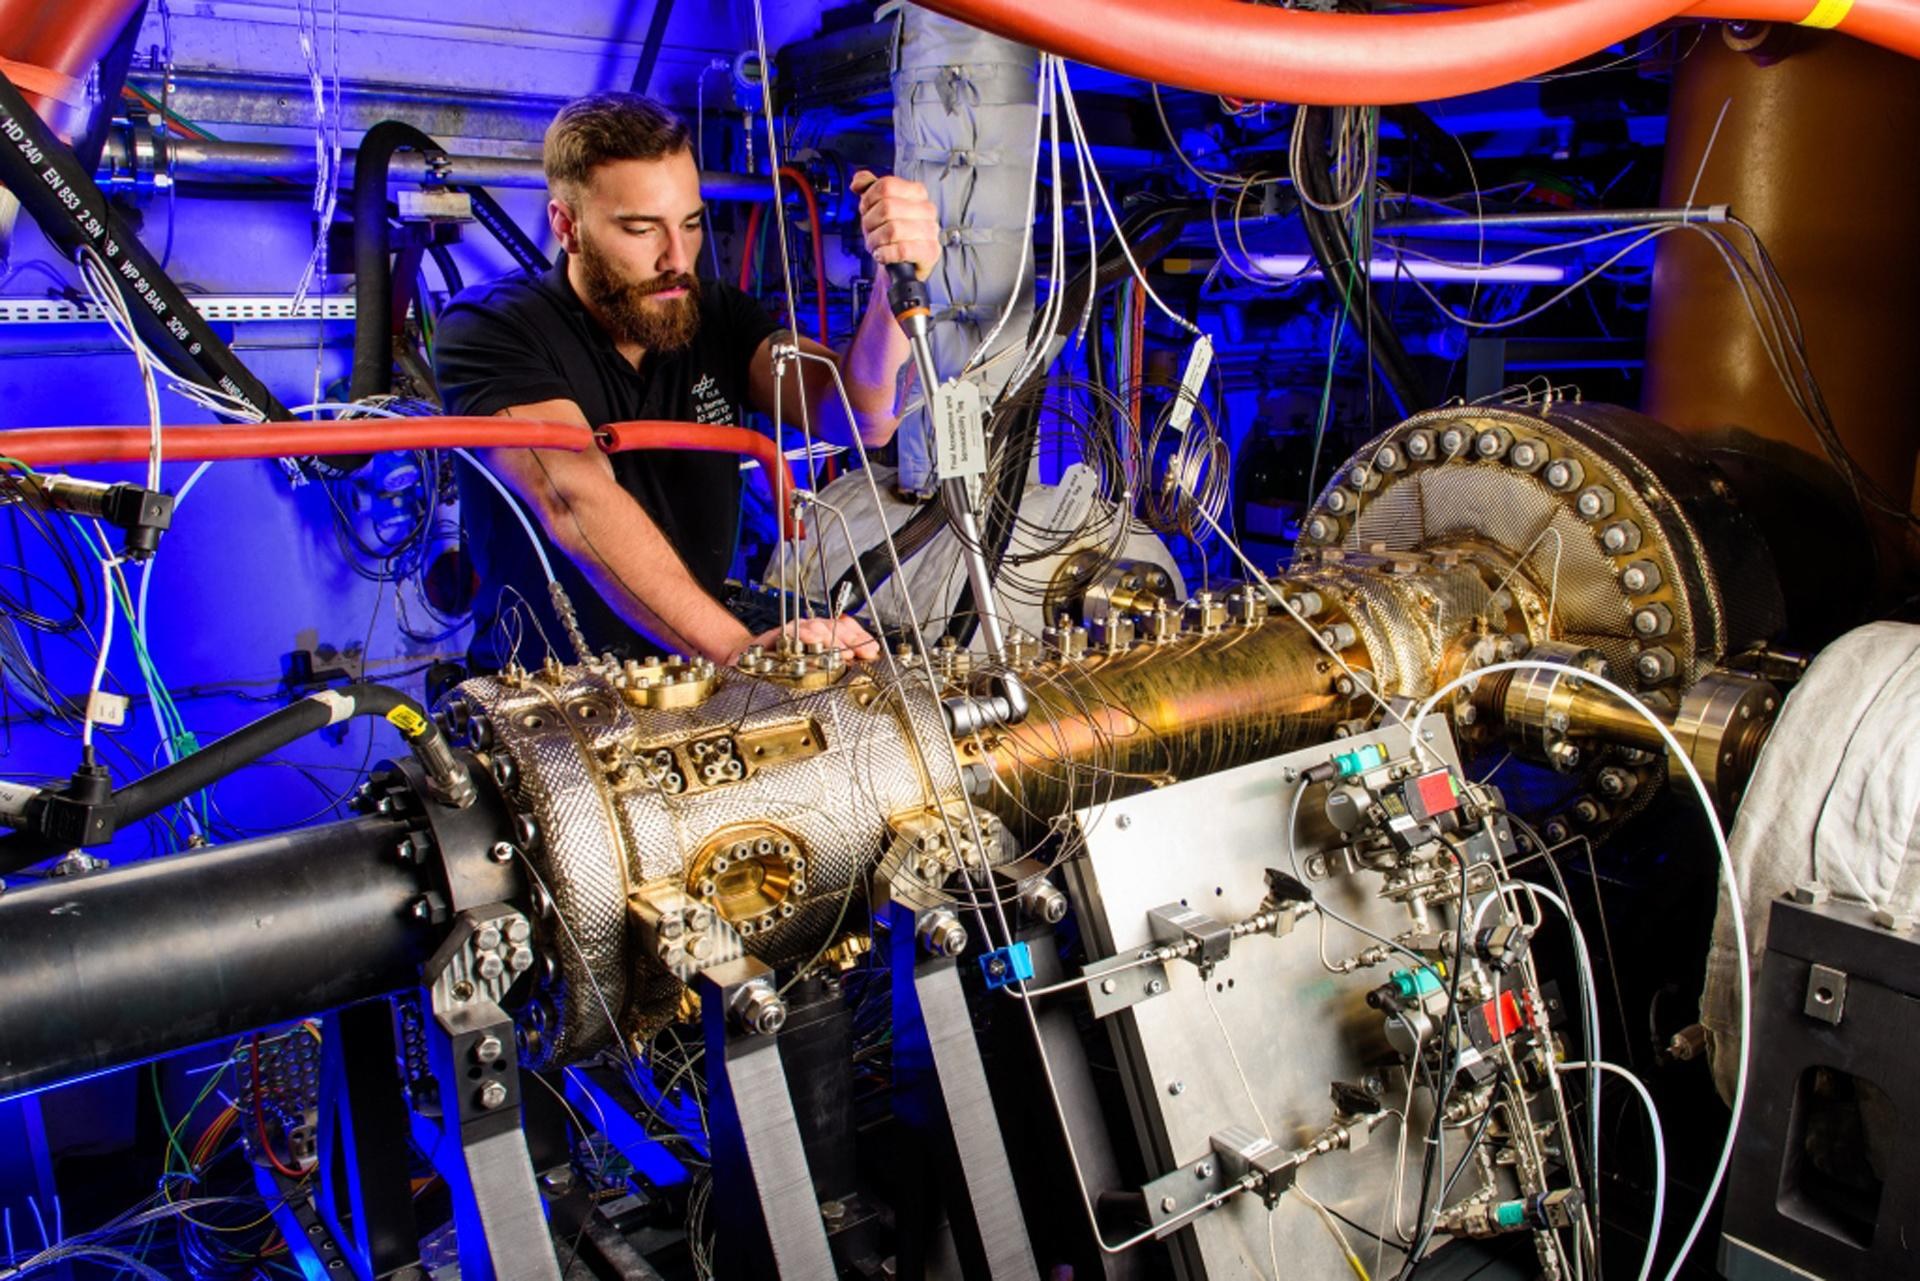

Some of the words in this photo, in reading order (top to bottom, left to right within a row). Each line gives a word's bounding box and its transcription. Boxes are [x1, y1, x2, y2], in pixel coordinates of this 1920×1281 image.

[1, 118, 24, 141] HD
[18, 139, 43, 164] 240
[42, 167, 63, 190] EN
[57, 186, 80, 210] 853
[76, 209, 90, 222] 2
[85, 218, 104, 238] SN
[120, 260, 140, 279] WP
[134, 277, 150, 293] 90
[144, 290, 167, 314] BAR
